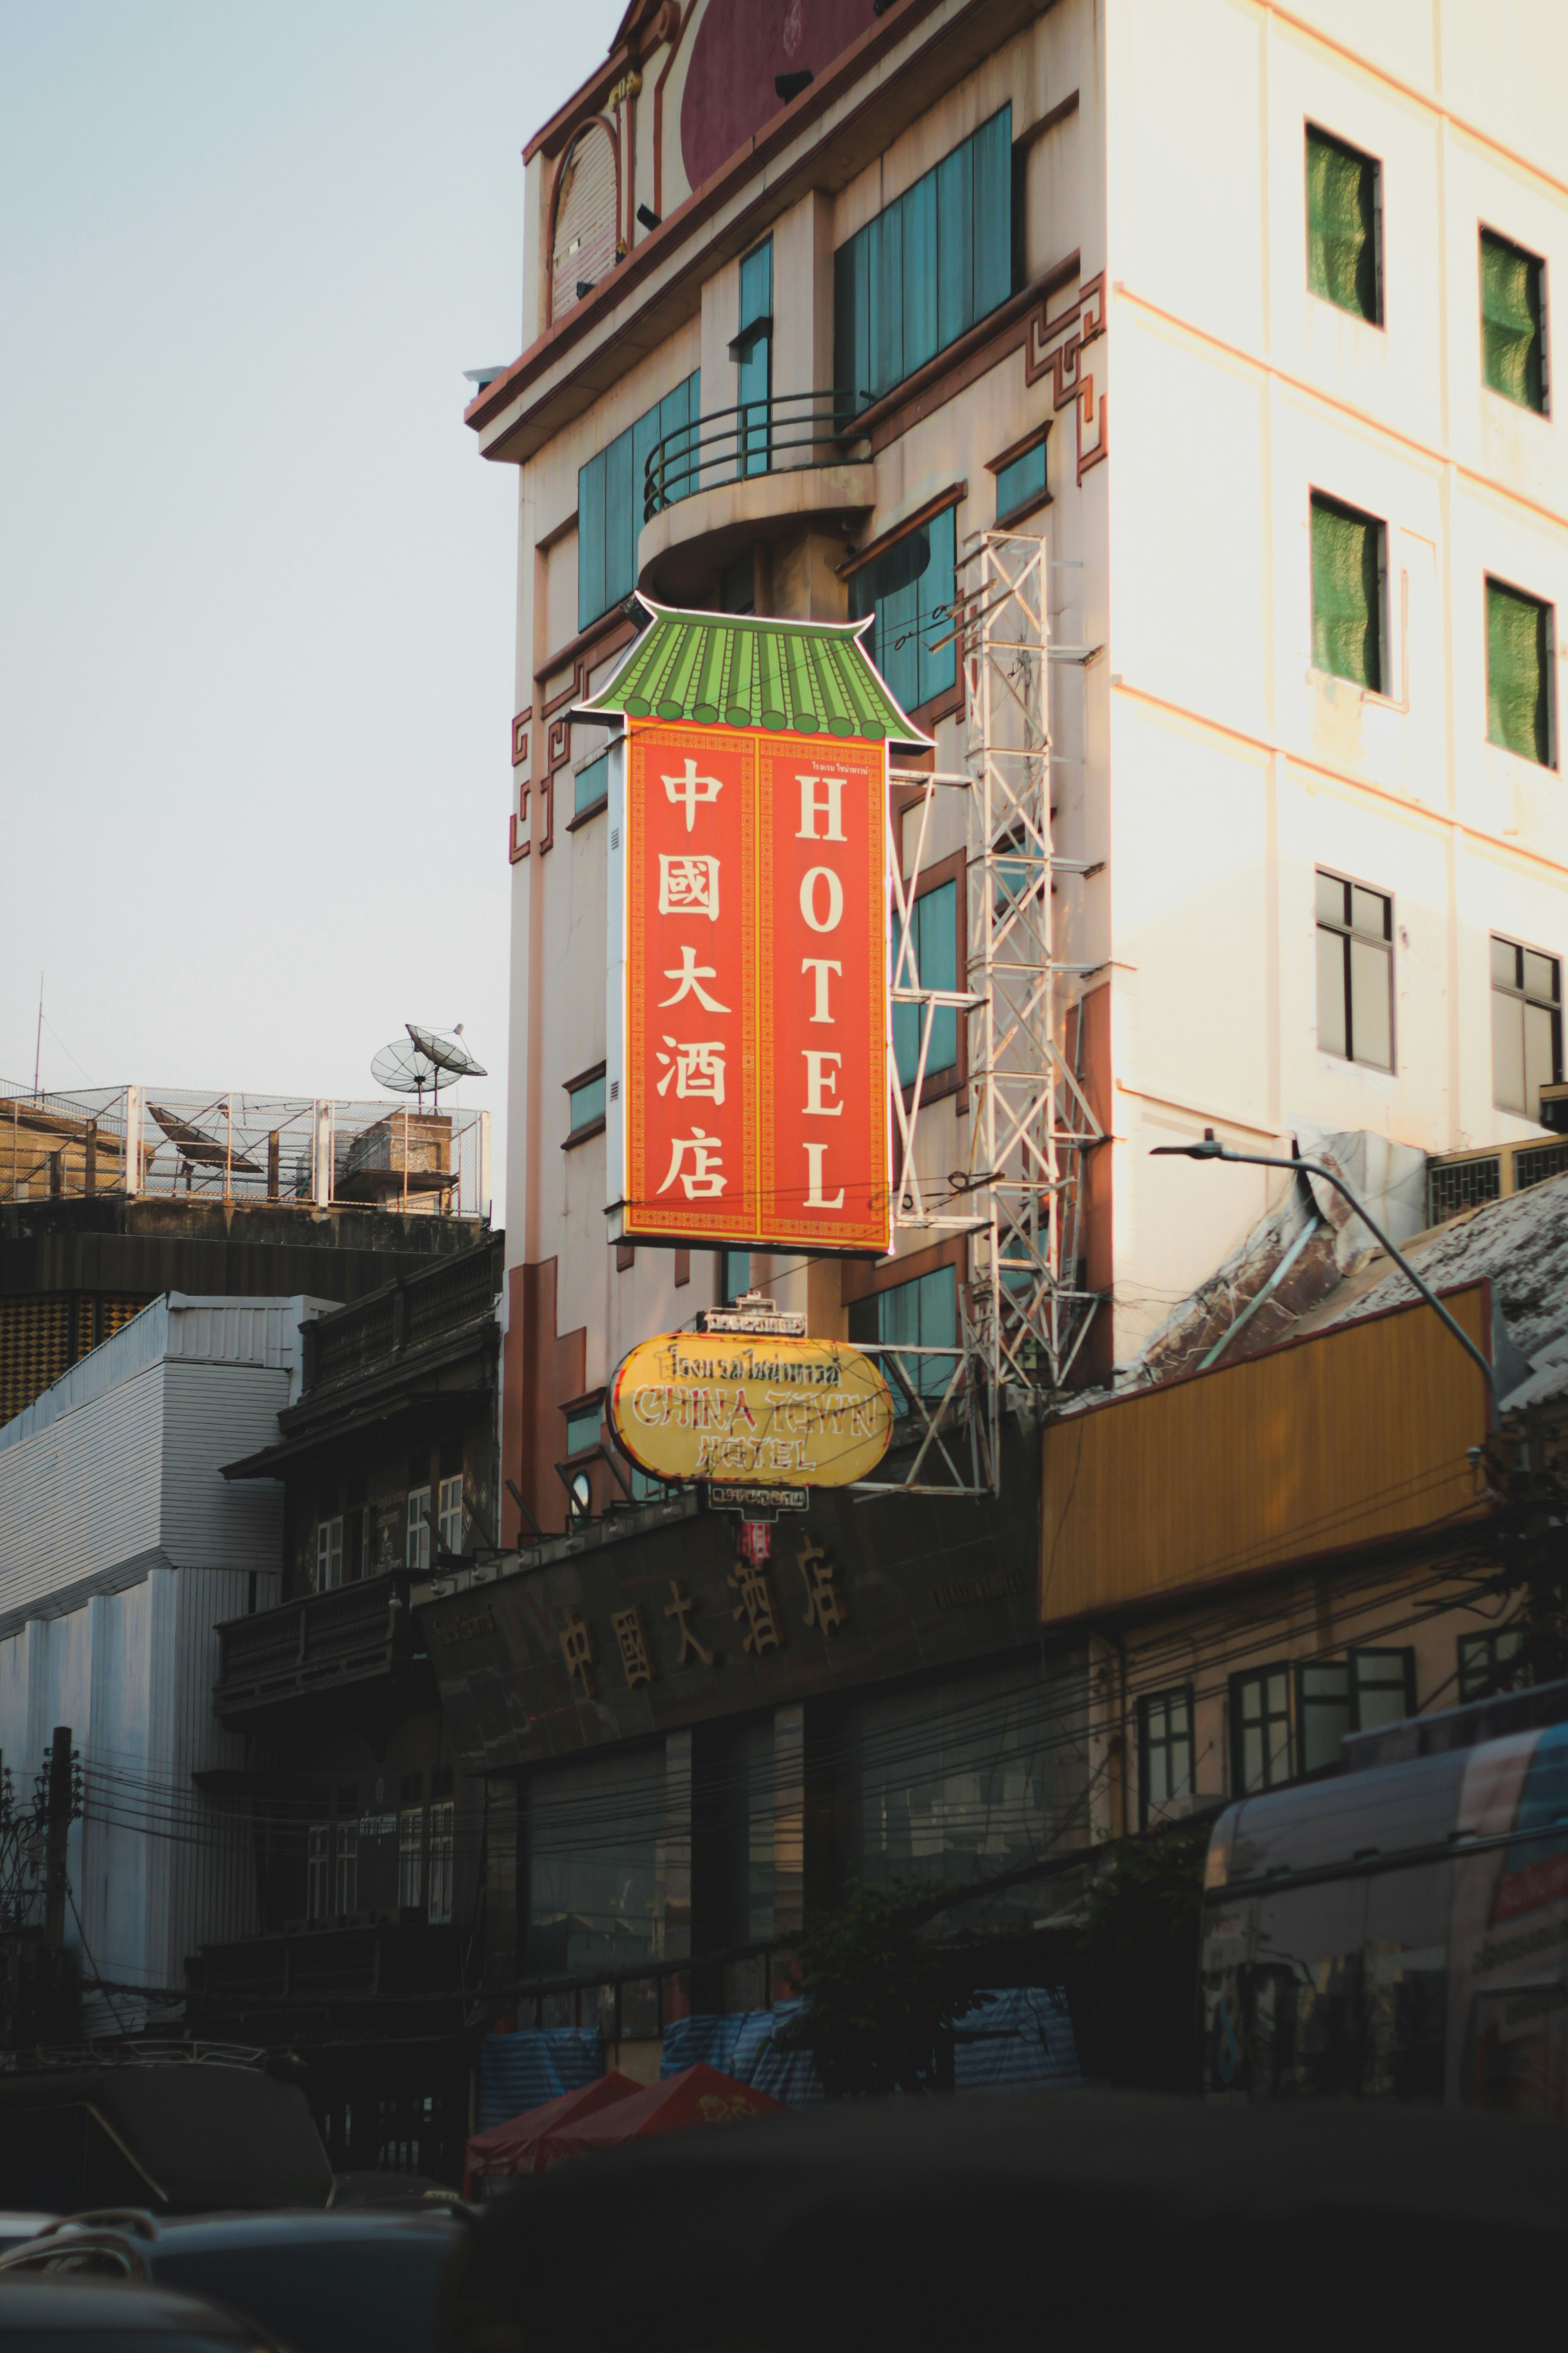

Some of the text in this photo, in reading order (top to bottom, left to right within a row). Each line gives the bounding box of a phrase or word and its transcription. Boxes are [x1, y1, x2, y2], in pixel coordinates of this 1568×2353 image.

[656, 758, 732, 1200] 中國大酒店
[794, 775, 848, 1209] HOTEL
[632, 1384, 877, 1438] CHINA TOWN
[695, 1435, 816, 1471] HOTEL
[559, 1531, 846, 1699] 中國大酒店
